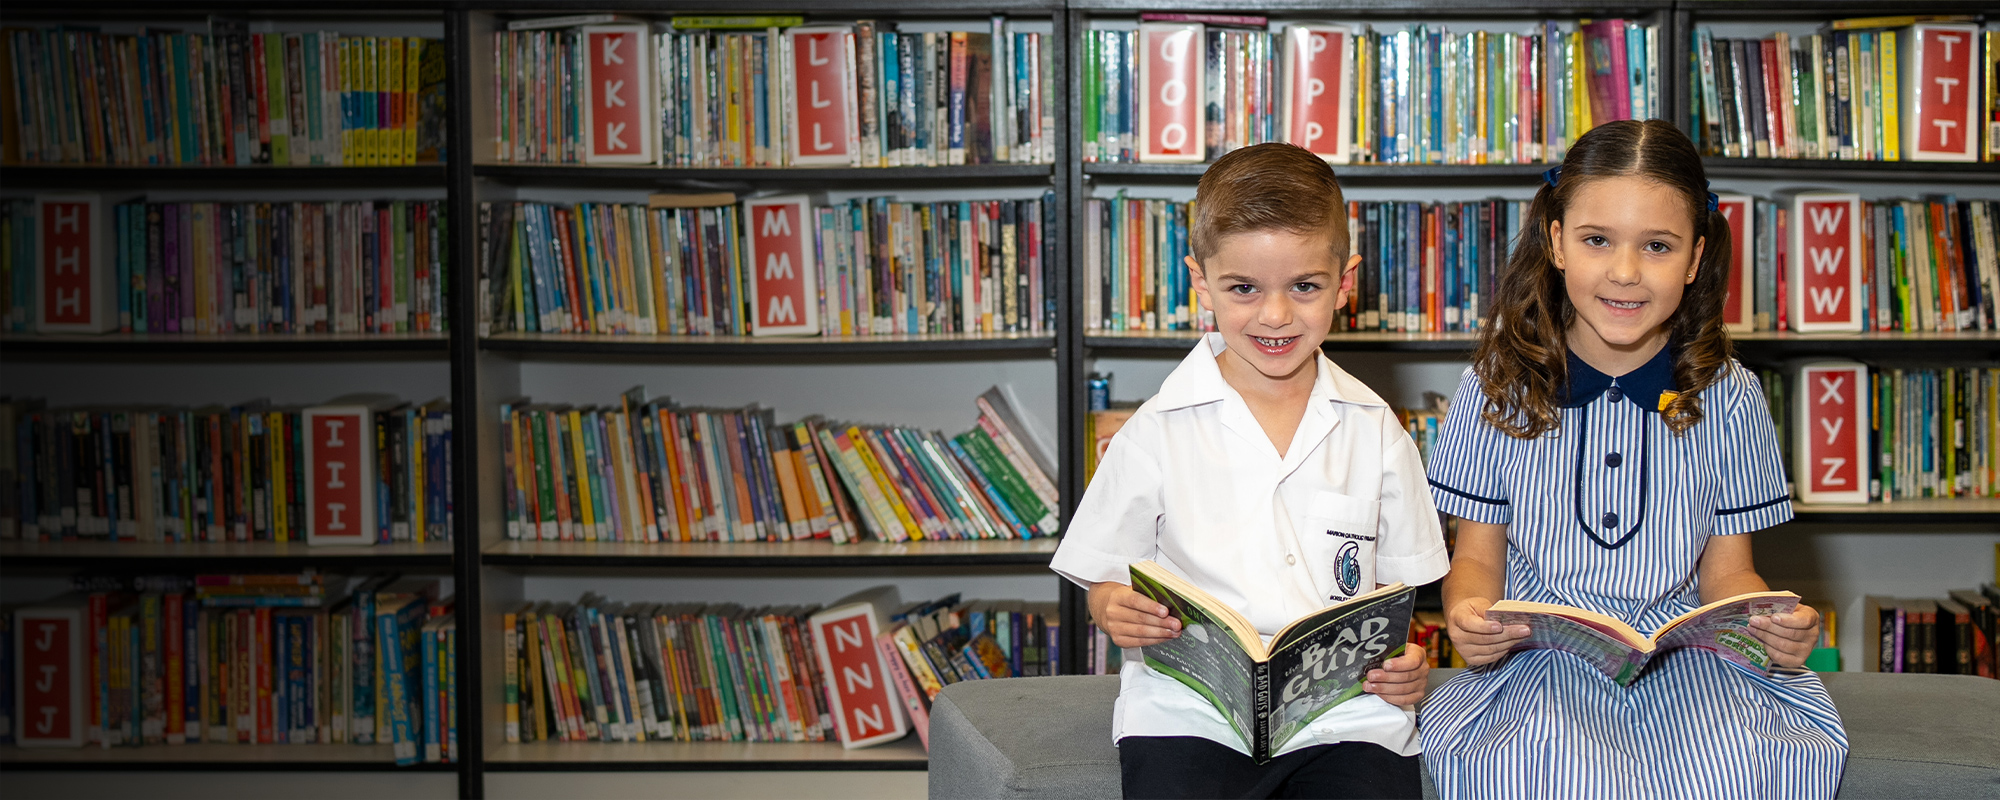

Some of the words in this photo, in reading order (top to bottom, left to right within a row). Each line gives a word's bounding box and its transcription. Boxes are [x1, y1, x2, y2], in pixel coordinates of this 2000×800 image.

[1326, 529, 1345, 538] MARION
[1294, 631, 1331, 654] AARON
[1336, 607, 1387, 632] BLABEY
[1301, 616, 1390, 673] BAD
[1718, 637, 1764, 665] FOREVER
[1721, 632, 1768, 657] FRIENDS
[1282, 633, 1390, 703] GUYS
[1257, 675, 1268, 690] BAD
[1257, 690, 1268, 711] GUYS
